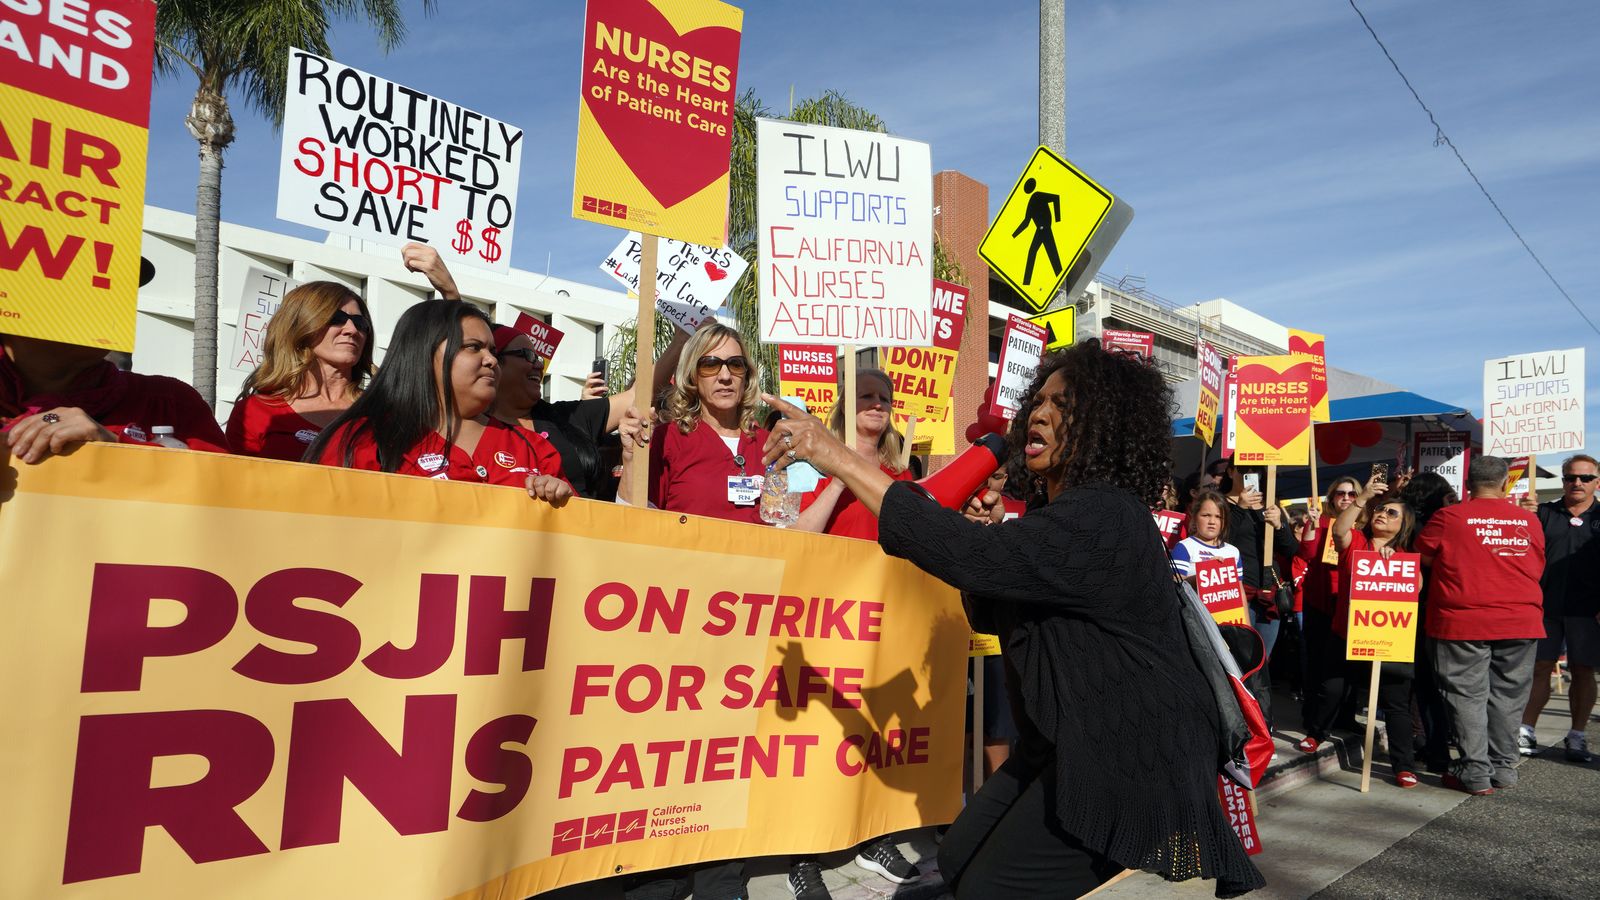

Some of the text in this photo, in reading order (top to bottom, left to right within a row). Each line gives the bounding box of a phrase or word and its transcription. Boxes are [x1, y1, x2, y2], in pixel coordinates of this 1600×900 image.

[595, 21, 731, 92] NURSES
[592, 58, 728, 116] Are the Heart
[294, 52, 523, 163] ROUTINELY
[591, 85, 727, 137] of Patient Care
[319, 103, 499, 191] WORKED
[783, 132, 900, 182] ILWU
[294, 137, 512, 228] SHORT TO
[785, 186, 907, 225] SUPPORTS
[314, 182, 502, 263] SAVE $$
[770, 226, 923, 266] CALIFORNIA
[605, 257, 638, 289] #Lack
[772, 263, 885, 299] NURSES
[677, 281, 708, 316] Care
[530, 323, 549, 339] ON
[769, 302, 927, 341] ASSOCIATION
[1011, 316, 1046, 335] California Nurses
[1016, 324, 1040, 337] Association
[1106, 331, 1131, 339] California
[783, 350, 833, 363] NURSES
[1008, 336, 1041, 357] PATIENTS
[784, 363, 833, 376] DEMAND
[891, 347, 954, 375] DON'T
[1204, 347, 1221, 374] SOME
[1497, 354, 1566, 381] ILWU
[889, 371, 938, 398] HEAL
[1203, 366, 1219, 391] CUTS
[1240, 381, 1309, 395] NURSES
[1498, 378, 1570, 400] SUPPORTS
[795, 388, 833, 403] FAIR
[1240, 396, 1308, 405] Are the Heart
[1239, 406, 1308, 415] of Patient Care
[1490, 397, 1580, 419] CALIFORNIA
[1197, 408, 1213, 431] HEAL
[1490, 415, 1556, 436] NURSES
[1420, 446, 1462, 457] PATIENTS
[1489, 431, 1583, 456] ASSOCIATION
[1424, 465, 1457, 475] BEFORE
[1467, 518, 1528, 527] #Medicare4All
[1476, 528, 1502, 537] Heal
[1482, 536, 1528, 546] America
[1199, 565, 1237, 588] SAFE
[1356, 559, 1416, 578] SAFE
[1202, 589, 1239, 604] STAFFING
[1355, 581, 1415, 593] STAFFING
[584, 582, 885, 642] ON STRIKE
[1354, 610, 1413, 628] NOW
[80, 562, 556, 694] PSJH
[1352, 639, 1393, 647] #SafeStaffing
[570, 664, 864, 716] FOR SAFE
[558, 727, 930, 800] PATIENT CARE
[651, 815, 686, 827] Nurses
[652, 803, 702, 817] California
[649, 823, 709, 839] Association
